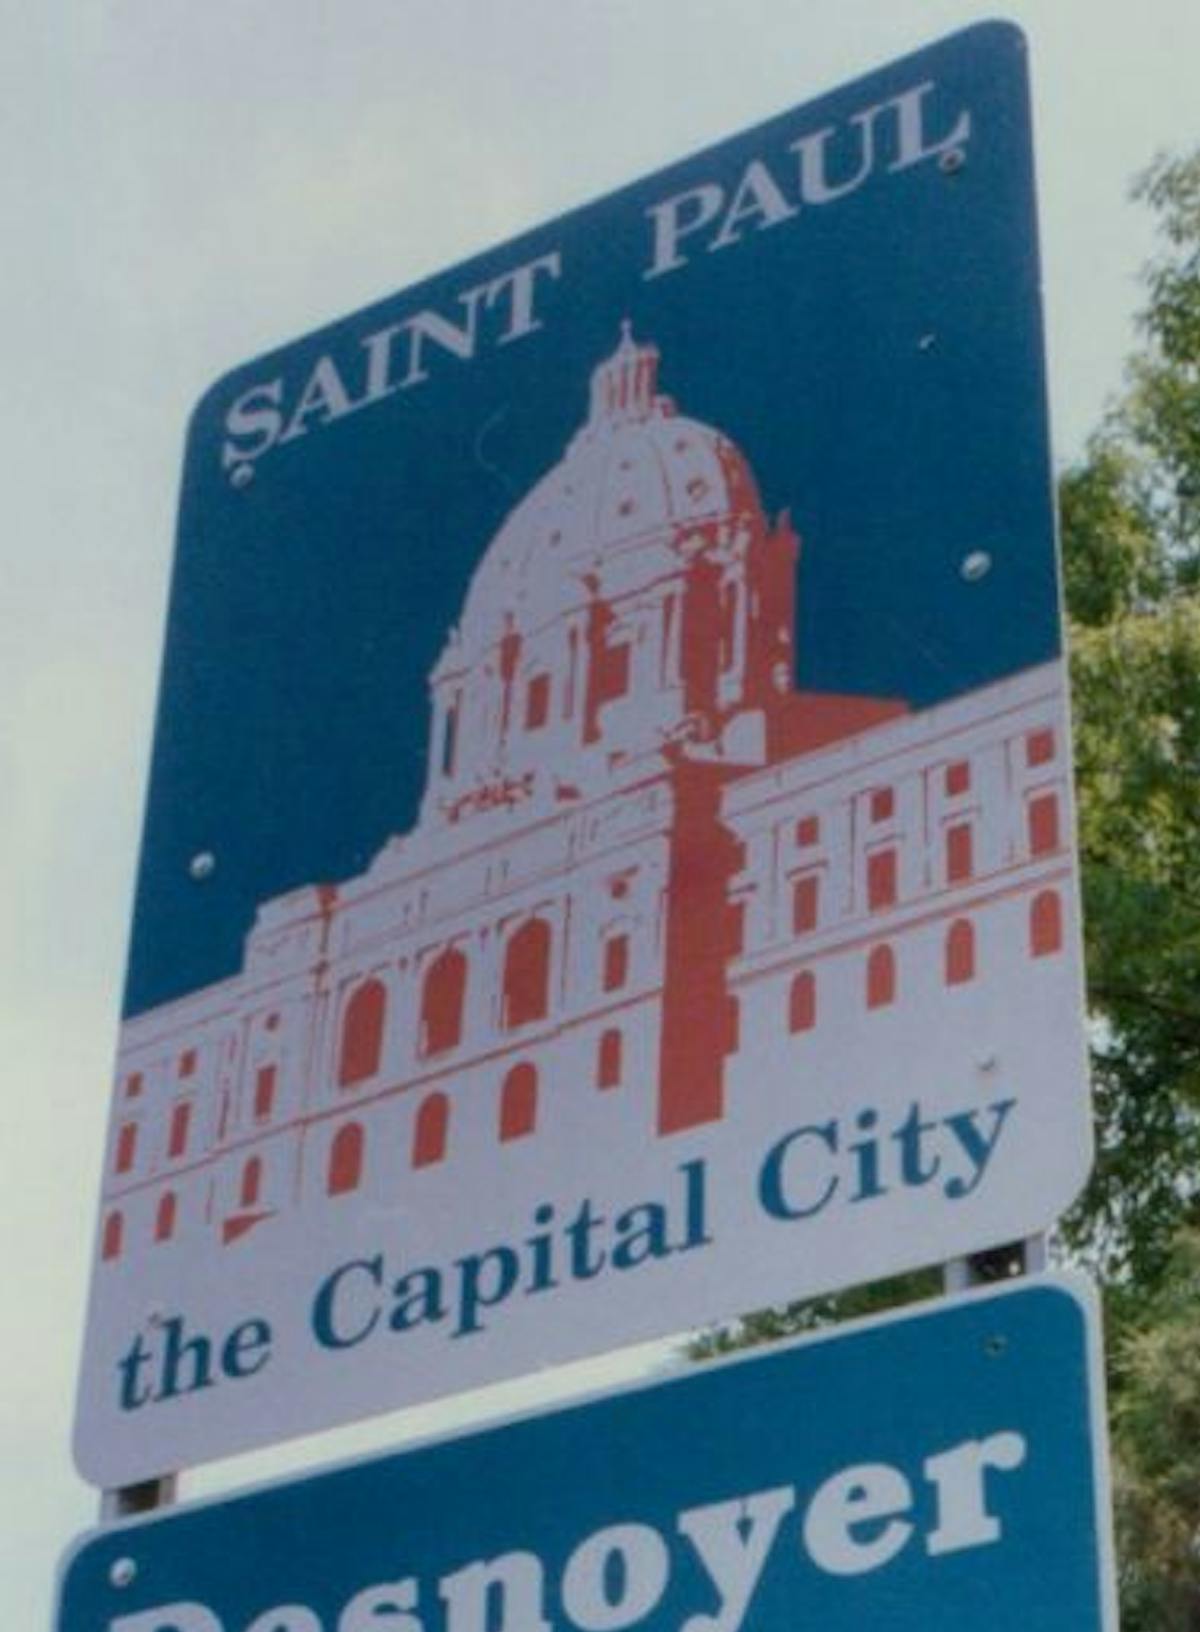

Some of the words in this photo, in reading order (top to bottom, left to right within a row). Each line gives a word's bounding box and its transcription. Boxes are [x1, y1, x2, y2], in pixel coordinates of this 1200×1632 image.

[223, 252, 561, 466] SAINT
[643, 81, 971, 281] PAUL
[116, 1317, 272, 1410] the
[310, 1158, 713, 1350] Capital
[758, 1098, 1019, 1221] City
